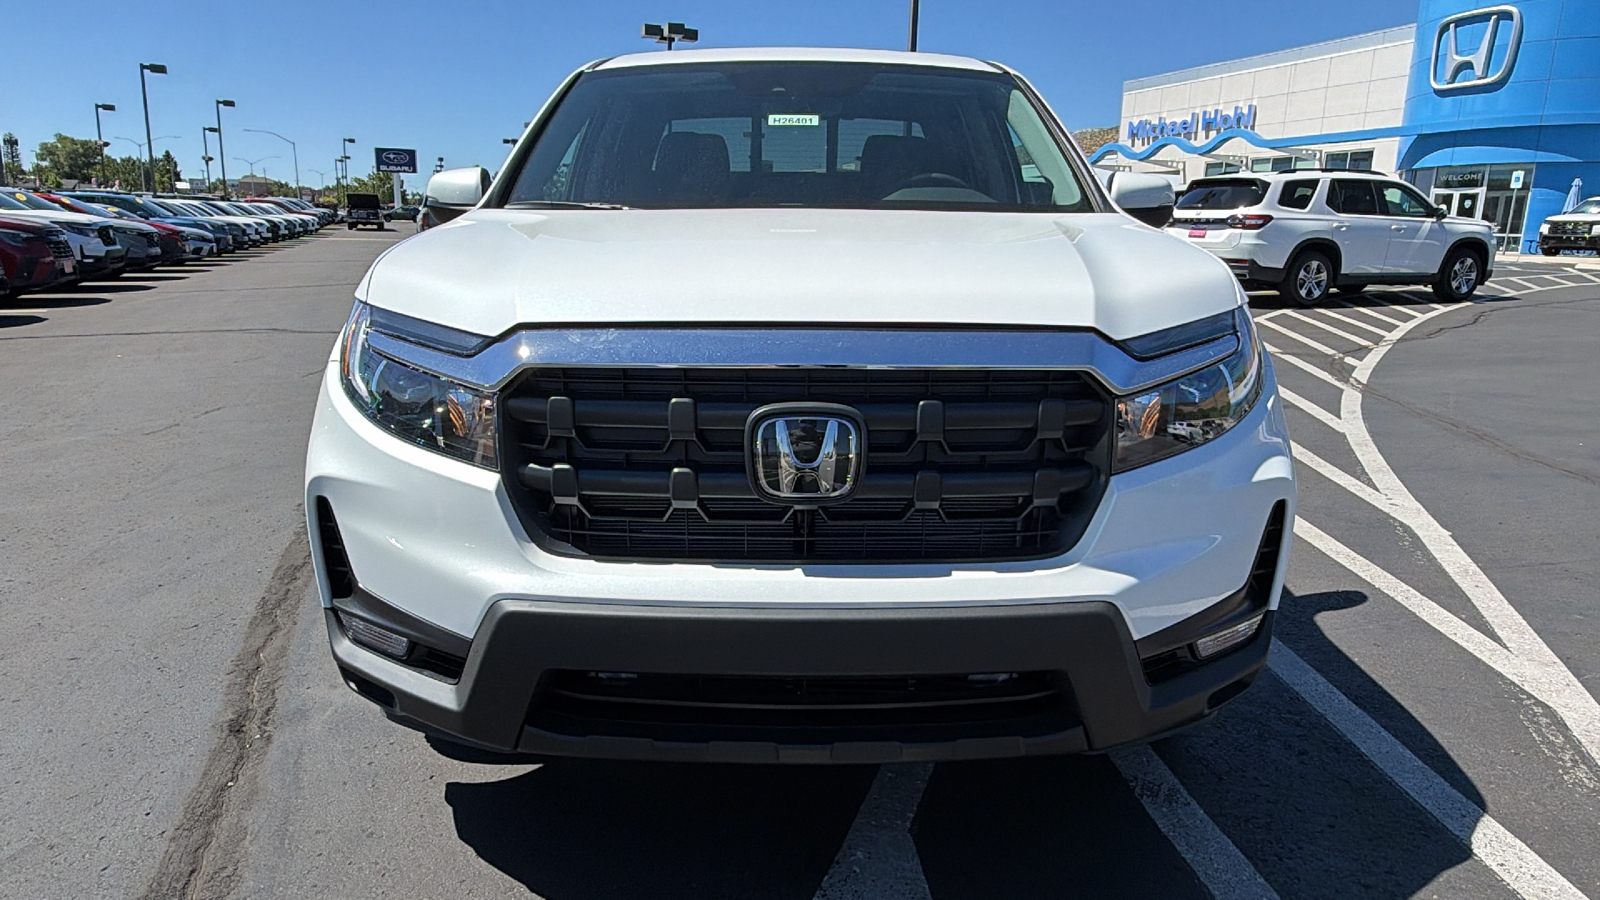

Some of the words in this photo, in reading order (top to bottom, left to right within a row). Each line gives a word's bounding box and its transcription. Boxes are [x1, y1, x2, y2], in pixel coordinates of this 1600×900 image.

[1127, 112, 1198, 140] Michael
[1201, 104, 1256, 131] Hohl
[1440, 173, 1482, 181] WELCOME
